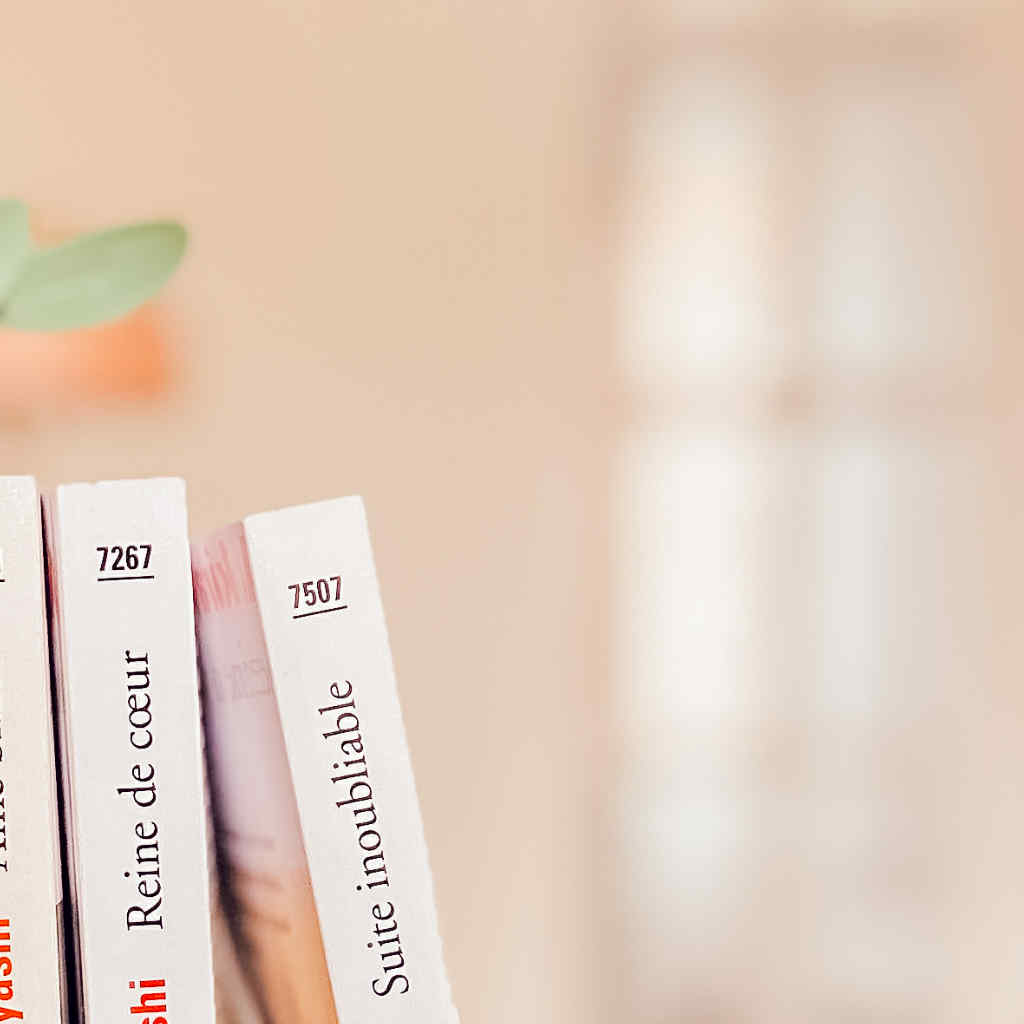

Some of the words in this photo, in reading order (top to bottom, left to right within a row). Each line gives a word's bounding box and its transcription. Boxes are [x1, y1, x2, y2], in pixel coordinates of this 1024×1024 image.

[96, 544, 153, 572] 7267
[287, 575, 344, 610] 7507
[124, 649, 153, 750] cœur
[116, 763, 156, 808] de
[317, 679, 391, 893] inoubliable
[123, 821, 164, 932] Reine
[366, 901, 410, 998] Suite
